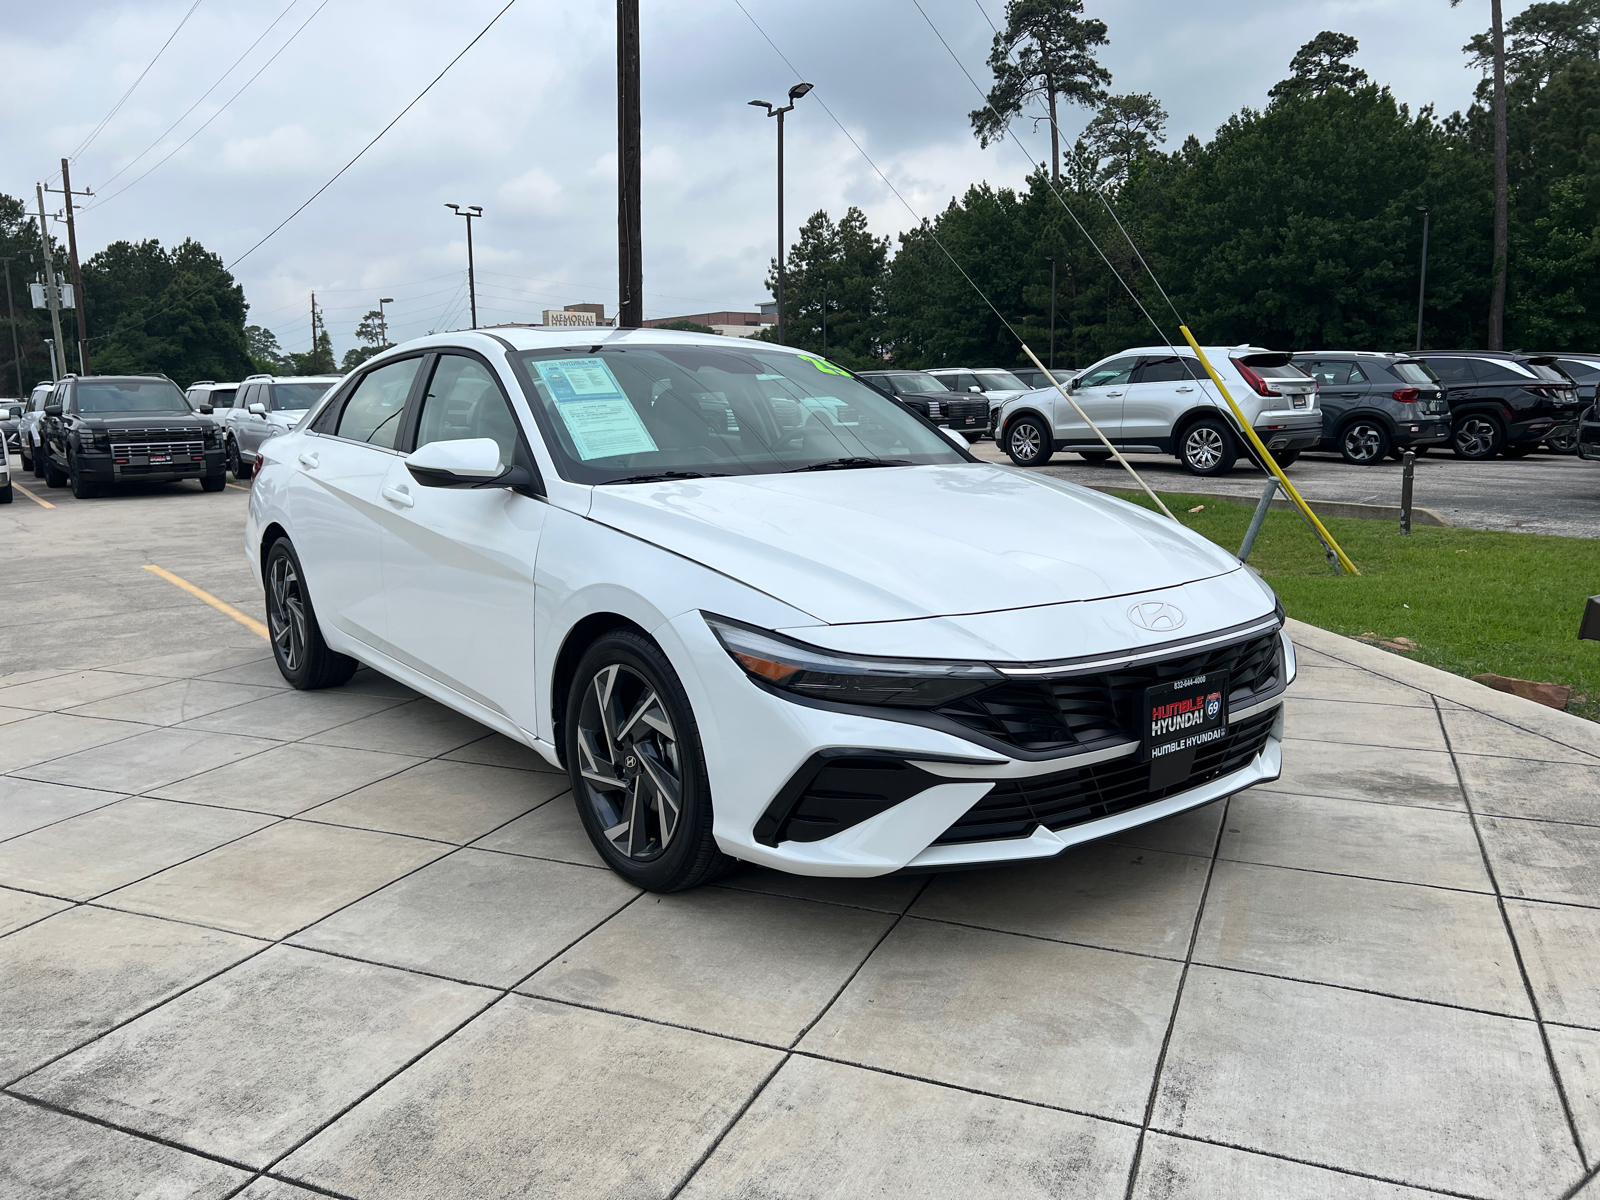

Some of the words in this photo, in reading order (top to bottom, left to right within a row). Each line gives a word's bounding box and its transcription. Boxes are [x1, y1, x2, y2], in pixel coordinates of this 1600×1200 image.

[551, 314, 594, 324] MEMORIAL
[1174, 675, 1206, 690] 832-644-4000
[1152, 696, 1204, 720] HUMBLE
[1207, 701, 1219, 715] 69
[1151, 709, 1204, 737] HYUNDAI
[1151, 739, 1186, 758] HUMBLE
[1186, 729, 1221, 747] HYUNDAI
